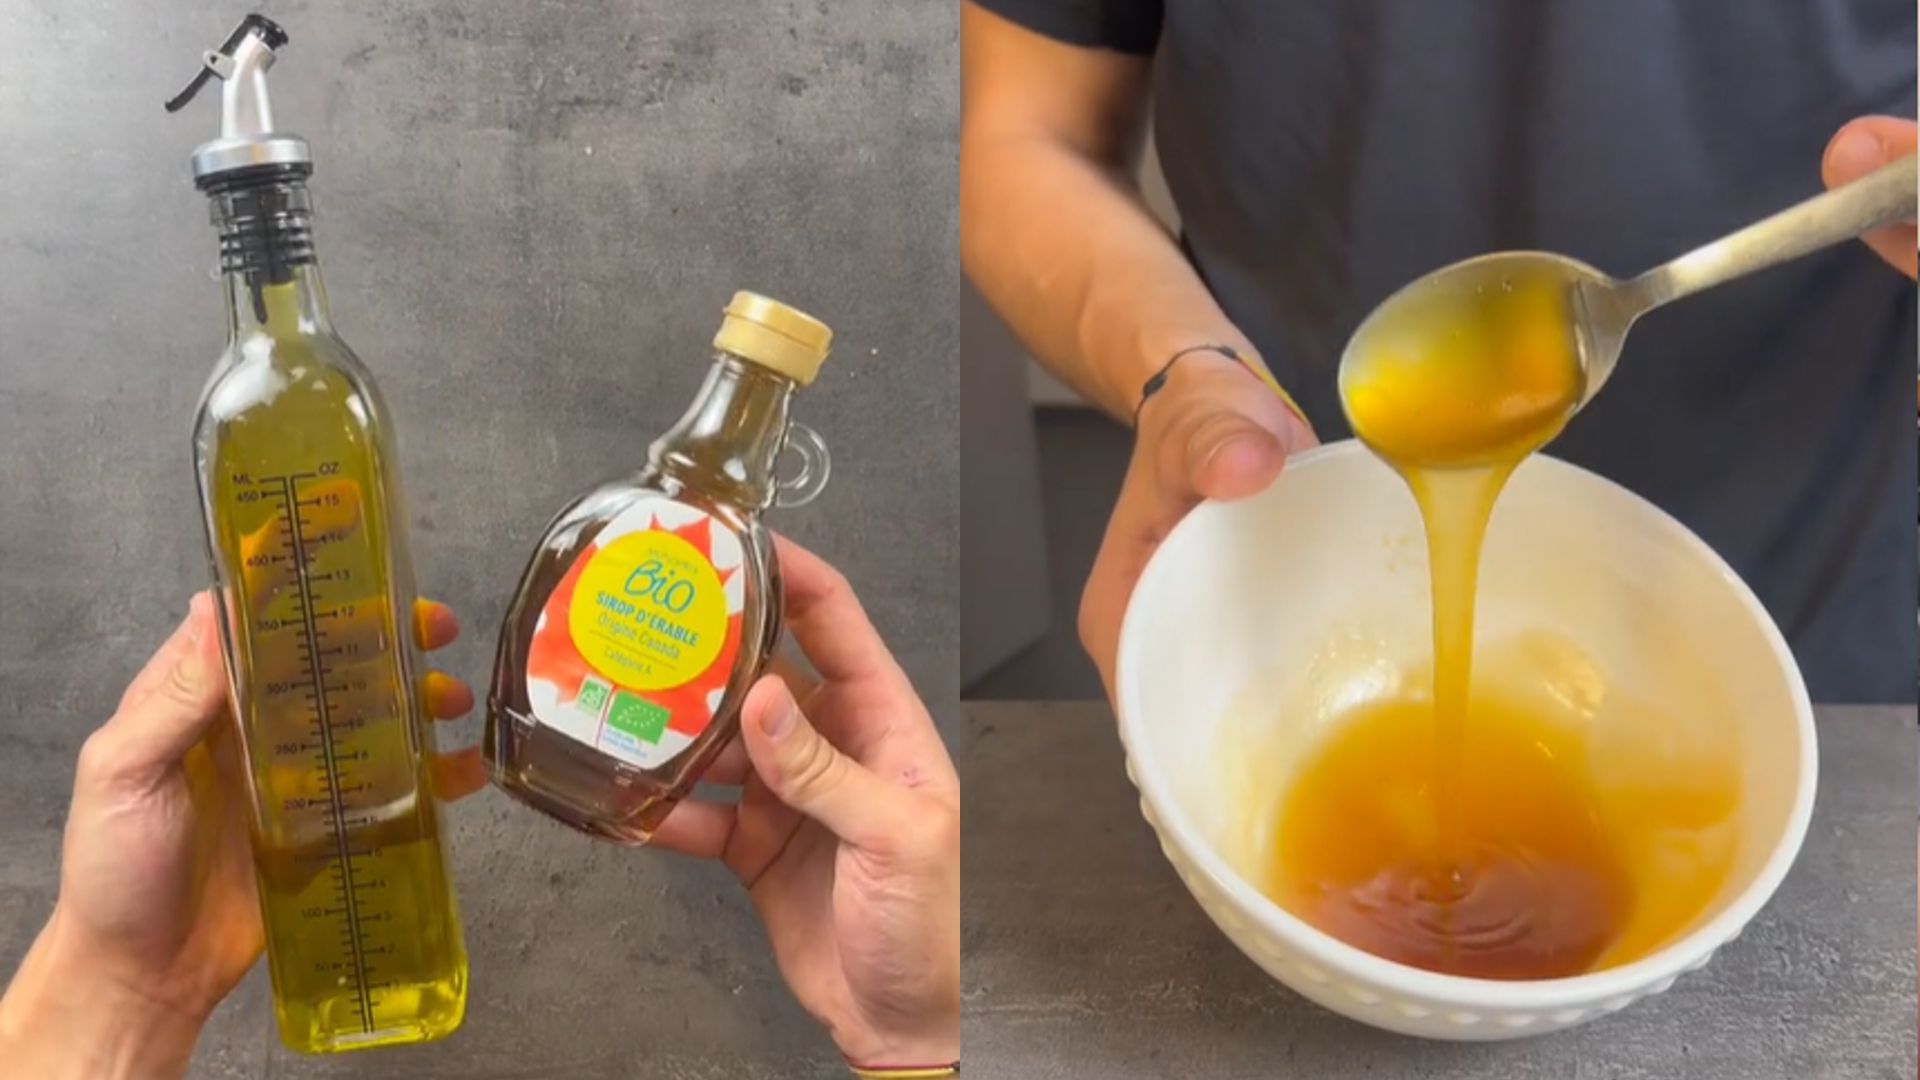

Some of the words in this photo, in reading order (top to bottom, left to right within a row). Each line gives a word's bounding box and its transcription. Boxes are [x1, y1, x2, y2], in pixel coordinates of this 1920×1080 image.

[319, 462, 339, 474] OZ
[233, 473, 253, 485] ML
[237, 491, 259, 502] 450
[325, 494, 340, 505] 15
[246, 555, 269, 567] 400
[596, 591, 635, 616] SIROP
[341, 606, 355, 617] 12
[598, 612, 637, 640] Origine
[638, 630, 681, 660] Canada
